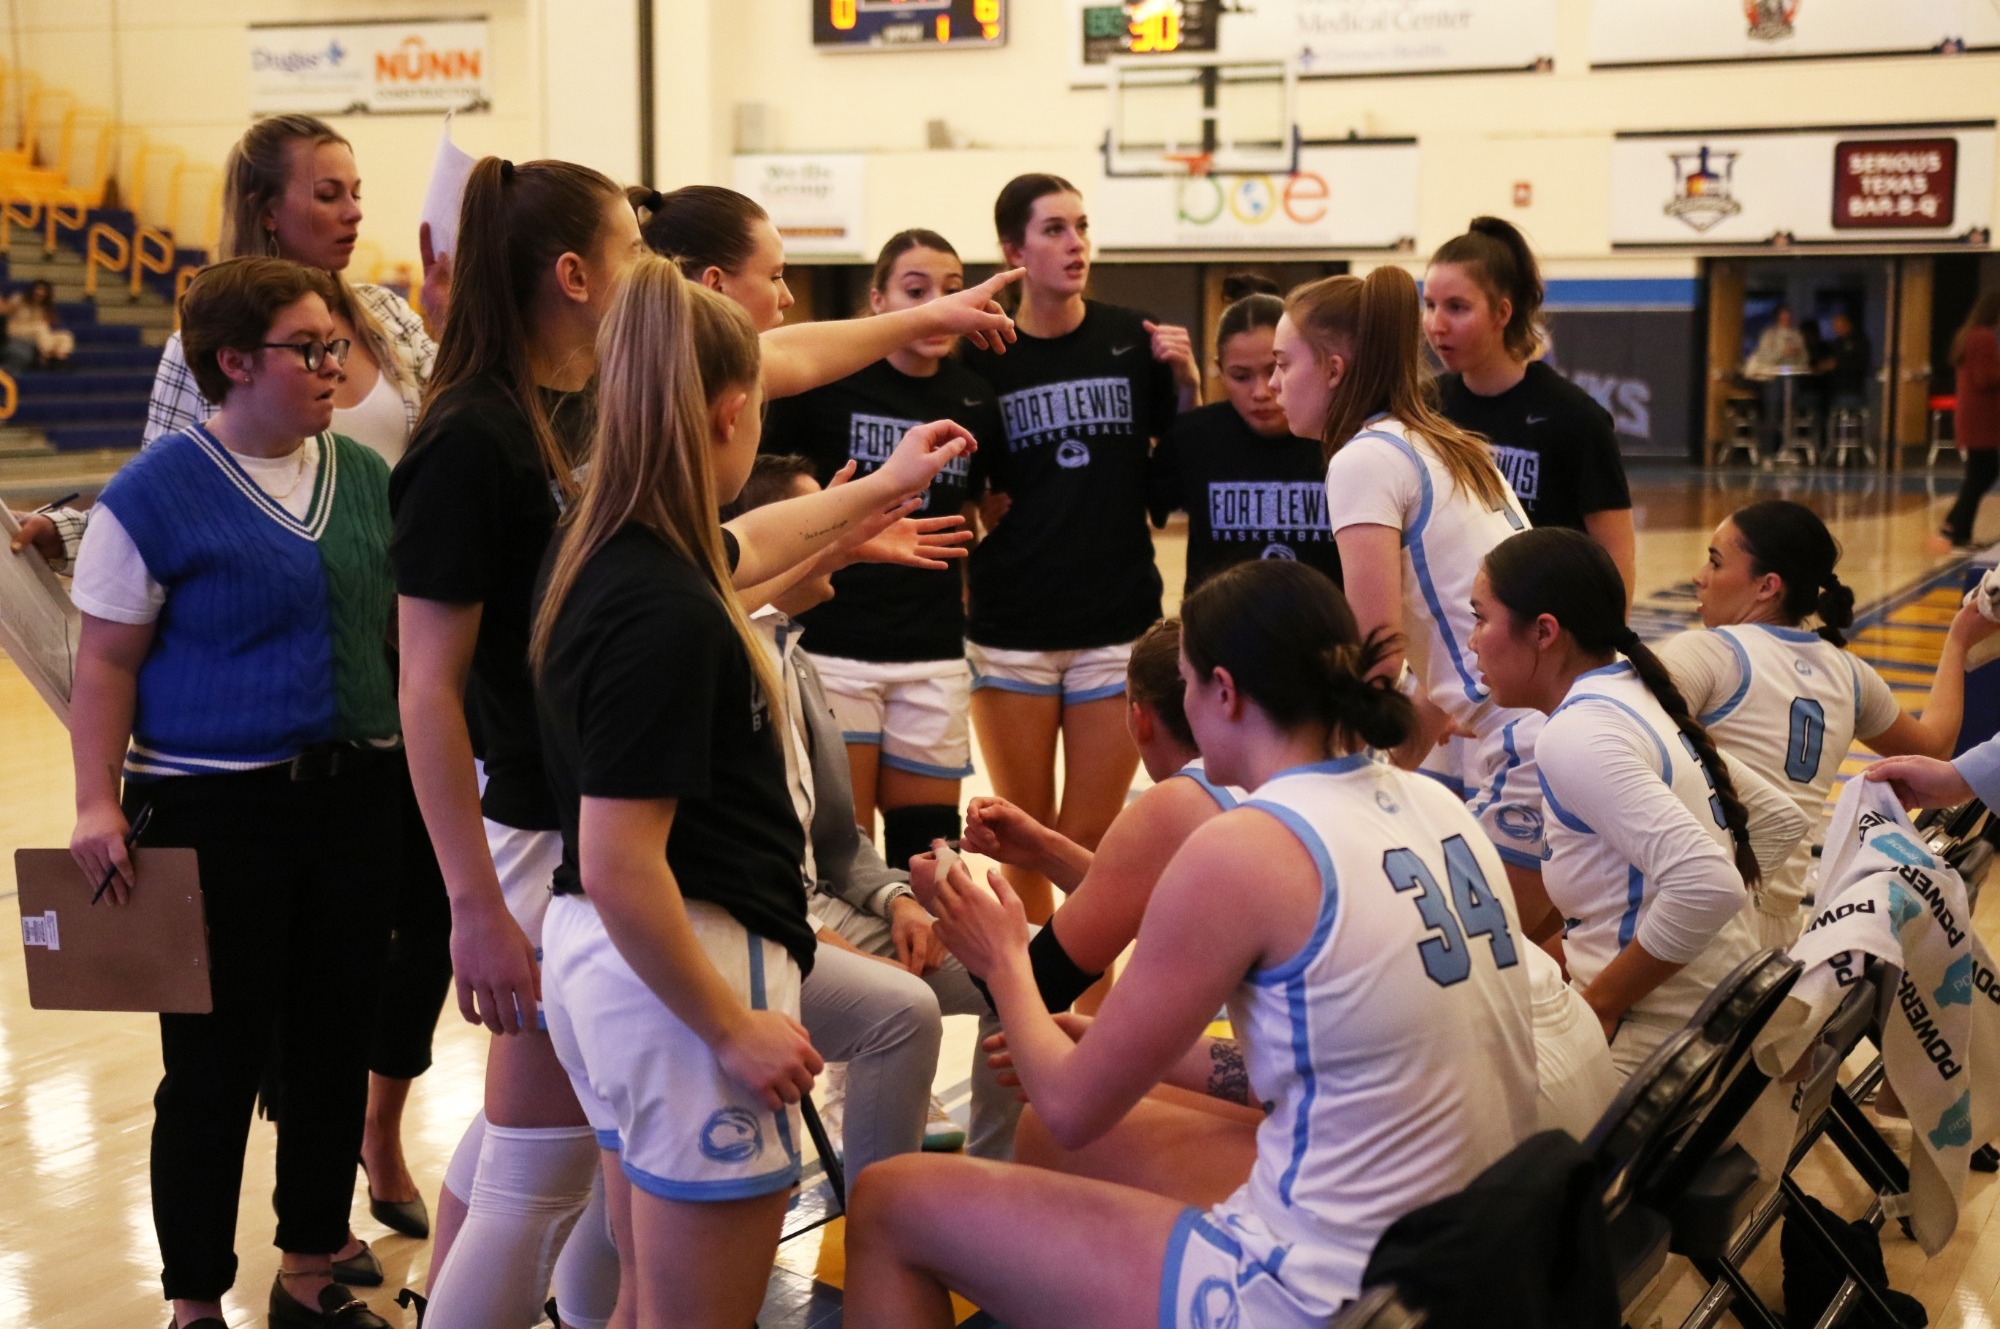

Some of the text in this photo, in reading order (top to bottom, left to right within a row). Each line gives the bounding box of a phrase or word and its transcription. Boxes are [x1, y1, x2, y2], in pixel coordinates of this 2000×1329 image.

[1848, 152, 1942, 174] SERIOUS
[1861, 174, 1928, 195] TEXAS
[1003, 384, 1129, 436] FORT LEWIS
[1009, 424, 1133, 453] BASKETBALL
[1212, 489, 1331, 525] FORT LEWI
[1212, 530, 1335, 542] BASKETBAL
[1784, 696, 1826, 784] 0
[1382, 833, 1519, 988] 34
[1806, 899, 1876, 933] POW
[1887, 864, 1966, 949] POWER
